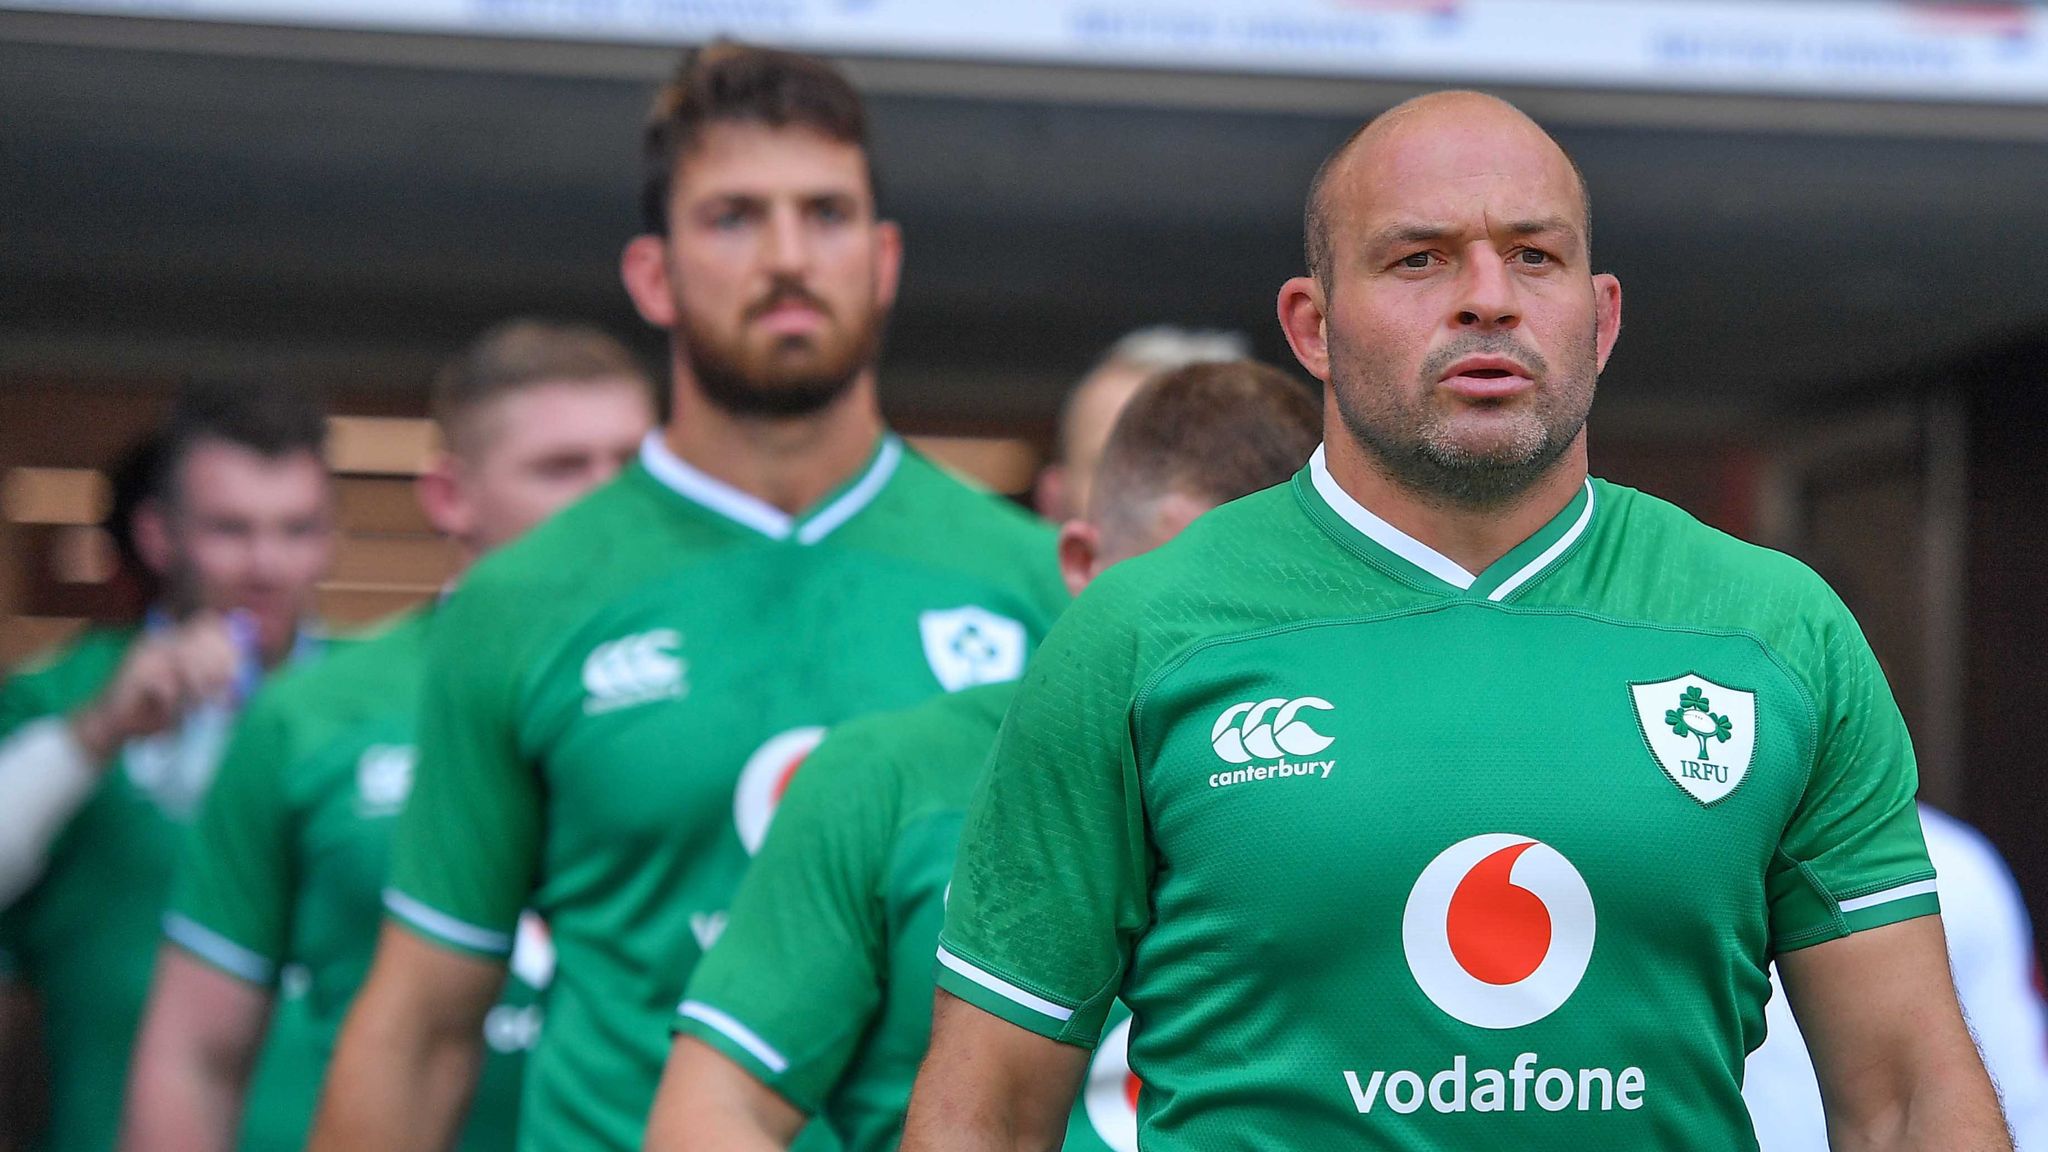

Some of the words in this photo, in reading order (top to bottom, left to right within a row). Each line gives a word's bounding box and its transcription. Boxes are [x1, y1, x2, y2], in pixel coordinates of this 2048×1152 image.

[1208, 758, 1336, 788] canterbury
[1680, 760, 1729, 784] IRFU
[1343, 1052, 1646, 1114] vodafone
